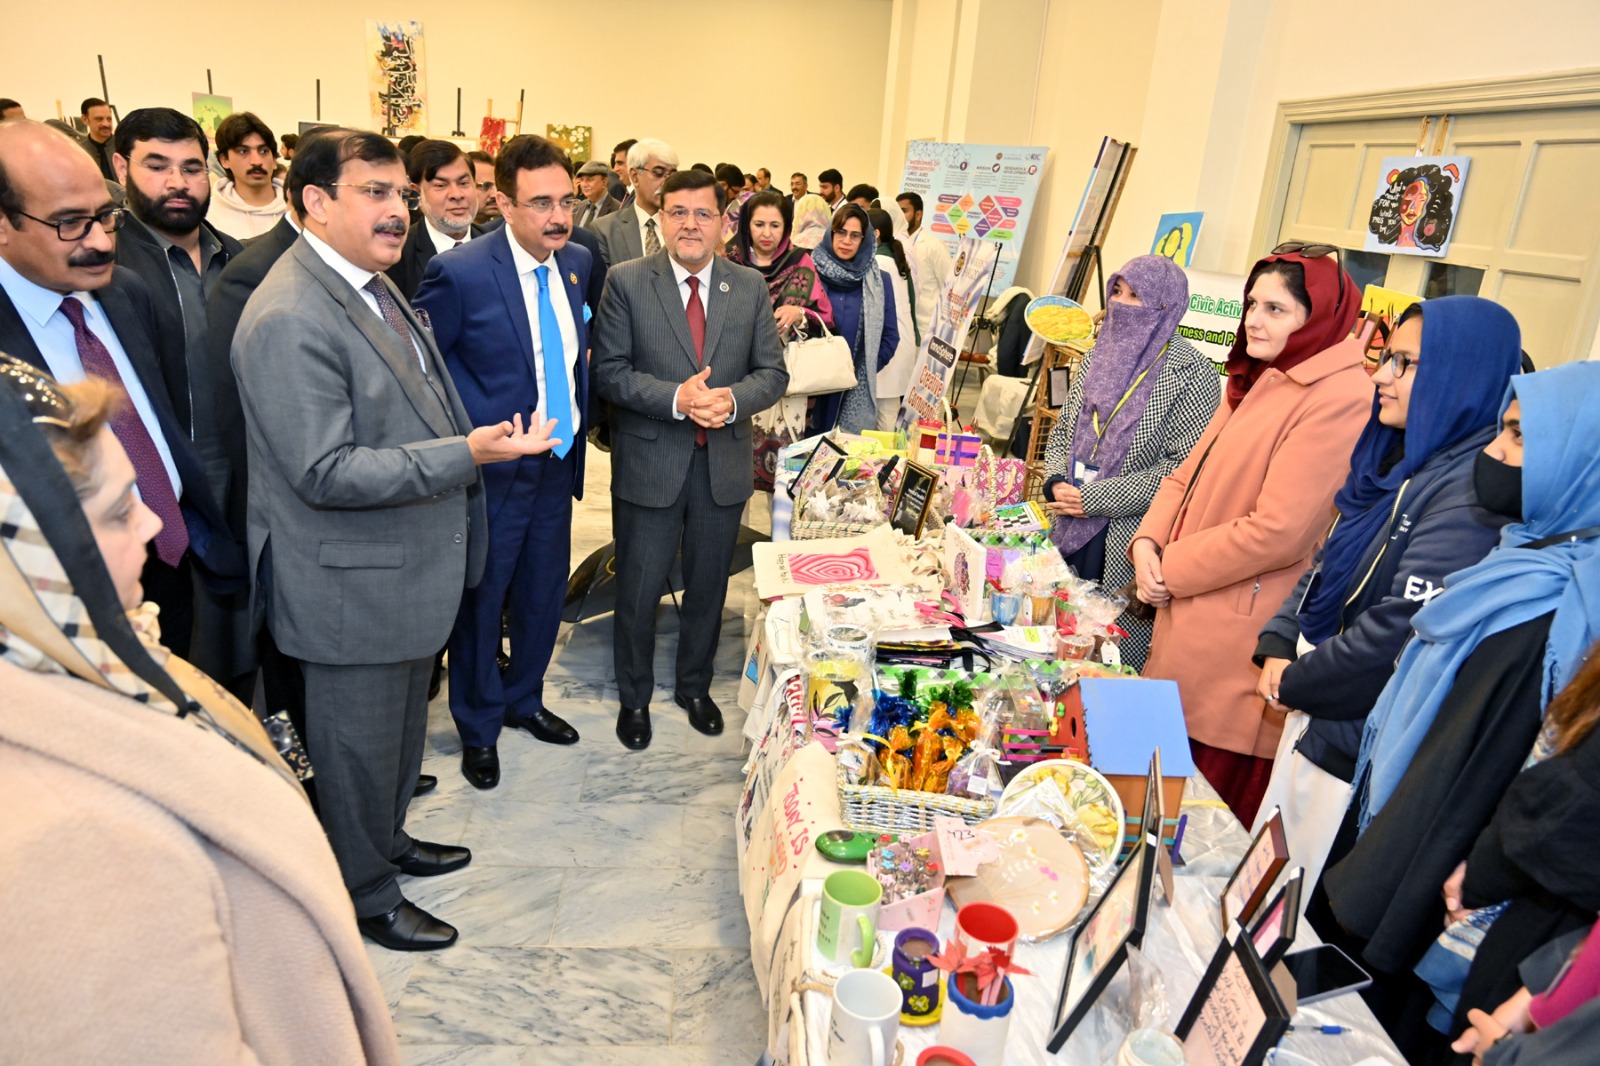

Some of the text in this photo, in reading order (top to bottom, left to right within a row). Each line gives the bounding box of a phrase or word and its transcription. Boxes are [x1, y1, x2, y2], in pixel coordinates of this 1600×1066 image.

[904, 182, 931, 190] PIONEERING
[1189, 295, 1214, 313] Civic
[1205, 330, 1226, 345] and
[919, 364, 943, 399] Creative
[790, 827, 809, 856] IS
